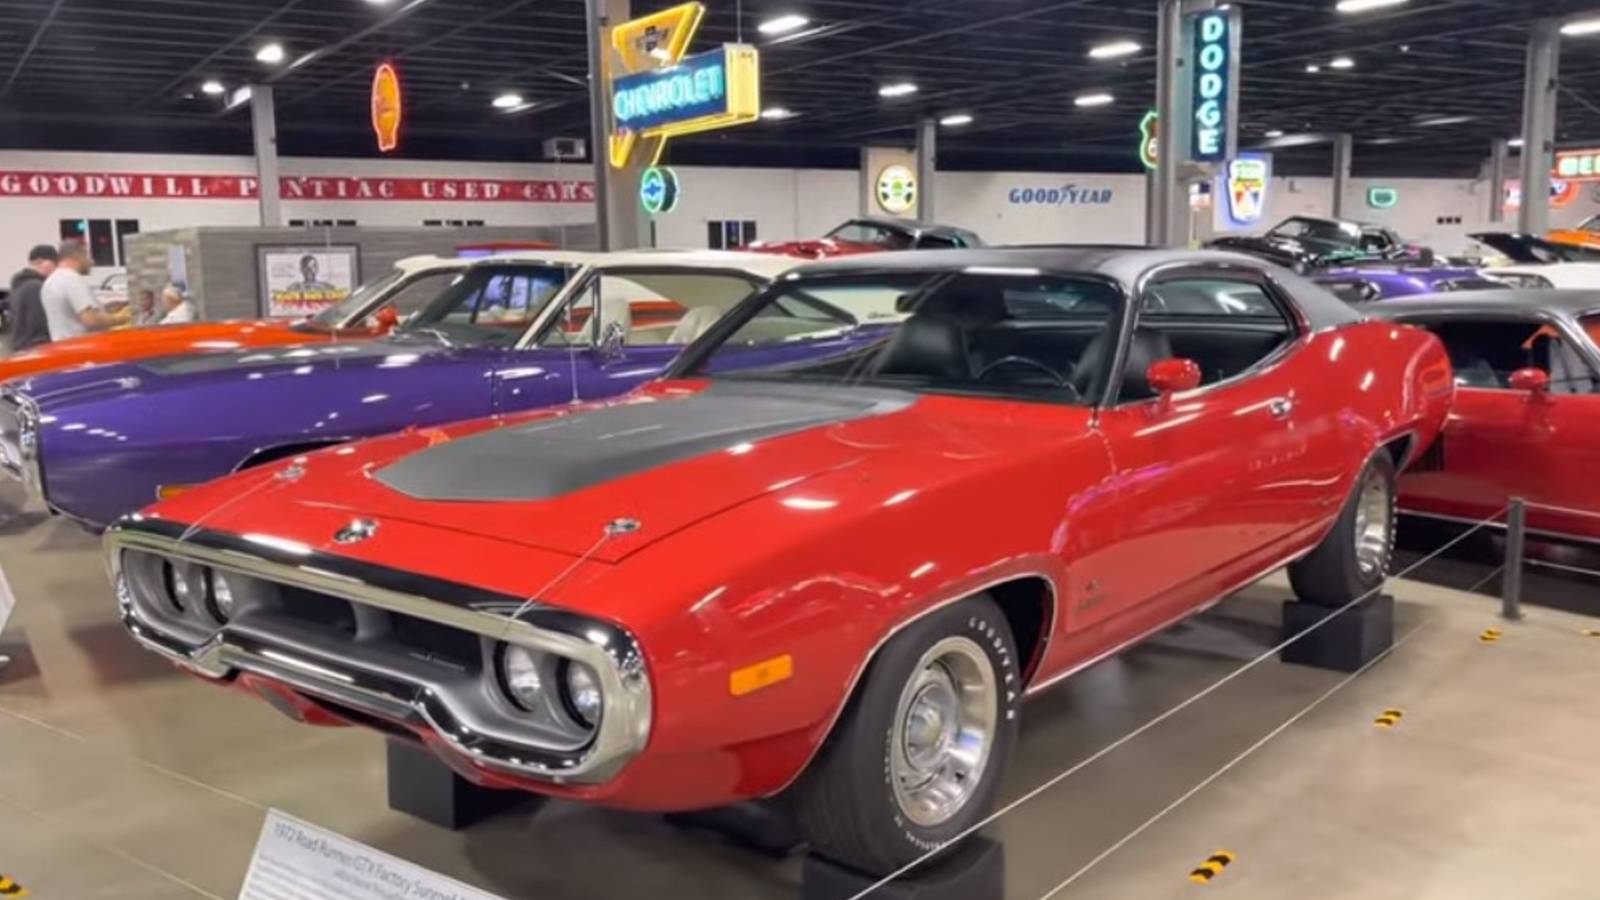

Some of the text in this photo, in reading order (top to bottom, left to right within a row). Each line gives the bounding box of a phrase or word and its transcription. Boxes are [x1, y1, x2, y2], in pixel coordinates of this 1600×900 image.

[614, 65, 723, 121] CHEVROLET
[1196, 16, 1224, 154] DODGE
[1, 174, 596, 199] GOODWILL PNTIAC USED CARS
[1008, 186, 1113, 204] GOODYEAR
